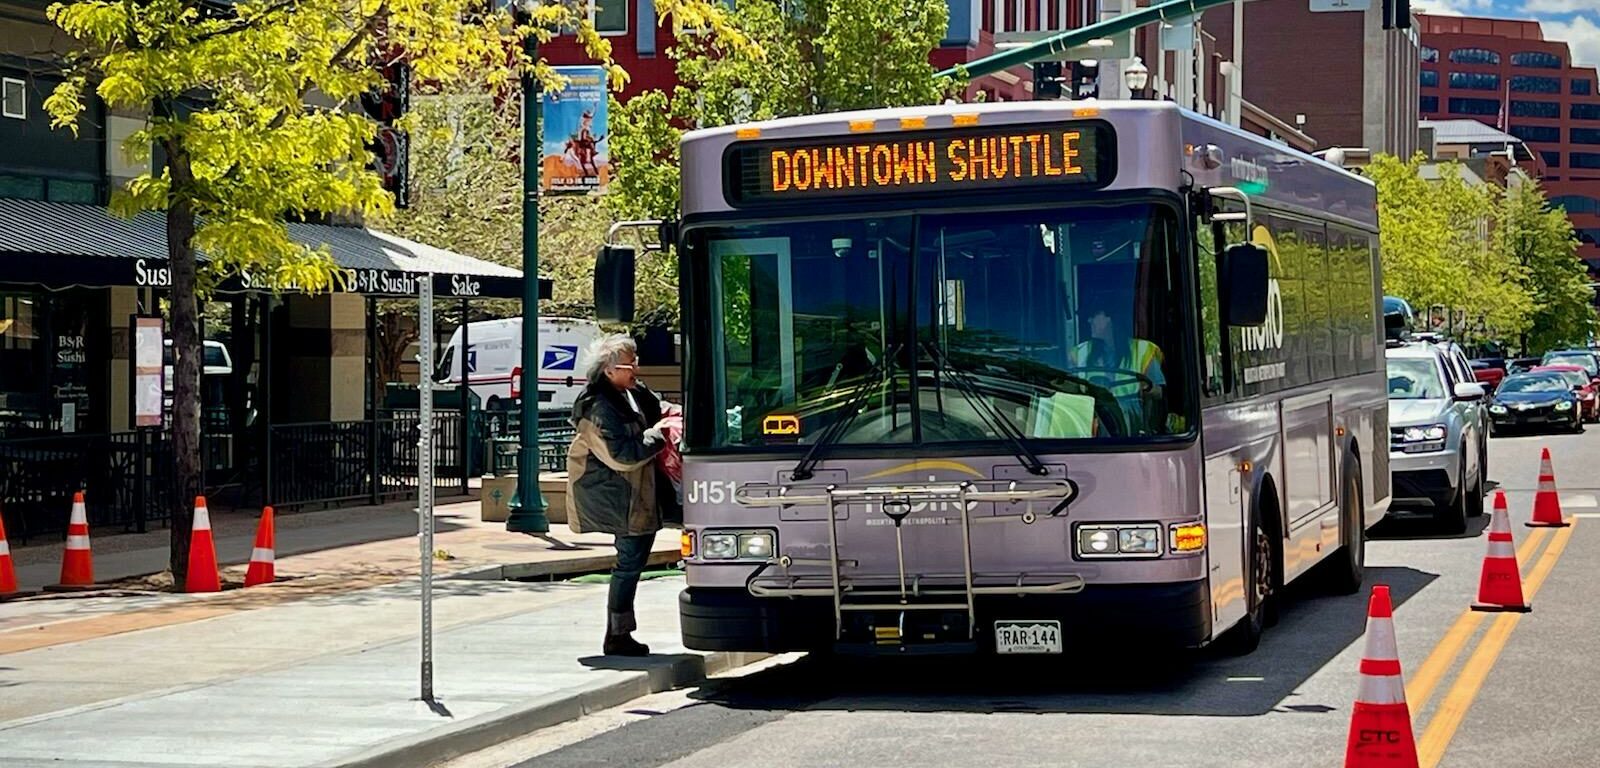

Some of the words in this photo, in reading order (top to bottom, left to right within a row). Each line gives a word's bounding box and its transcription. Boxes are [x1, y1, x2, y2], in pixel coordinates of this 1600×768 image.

[771, 142, 937, 192] DOWNTOWN
[948, 131, 1082, 181] SHUTTLE
[381, 270, 415, 294] Sushi
[451, 274, 480, 296] Sake
[57, 351, 86, 363] Sushi
[688, 480, 737, 504] J151
